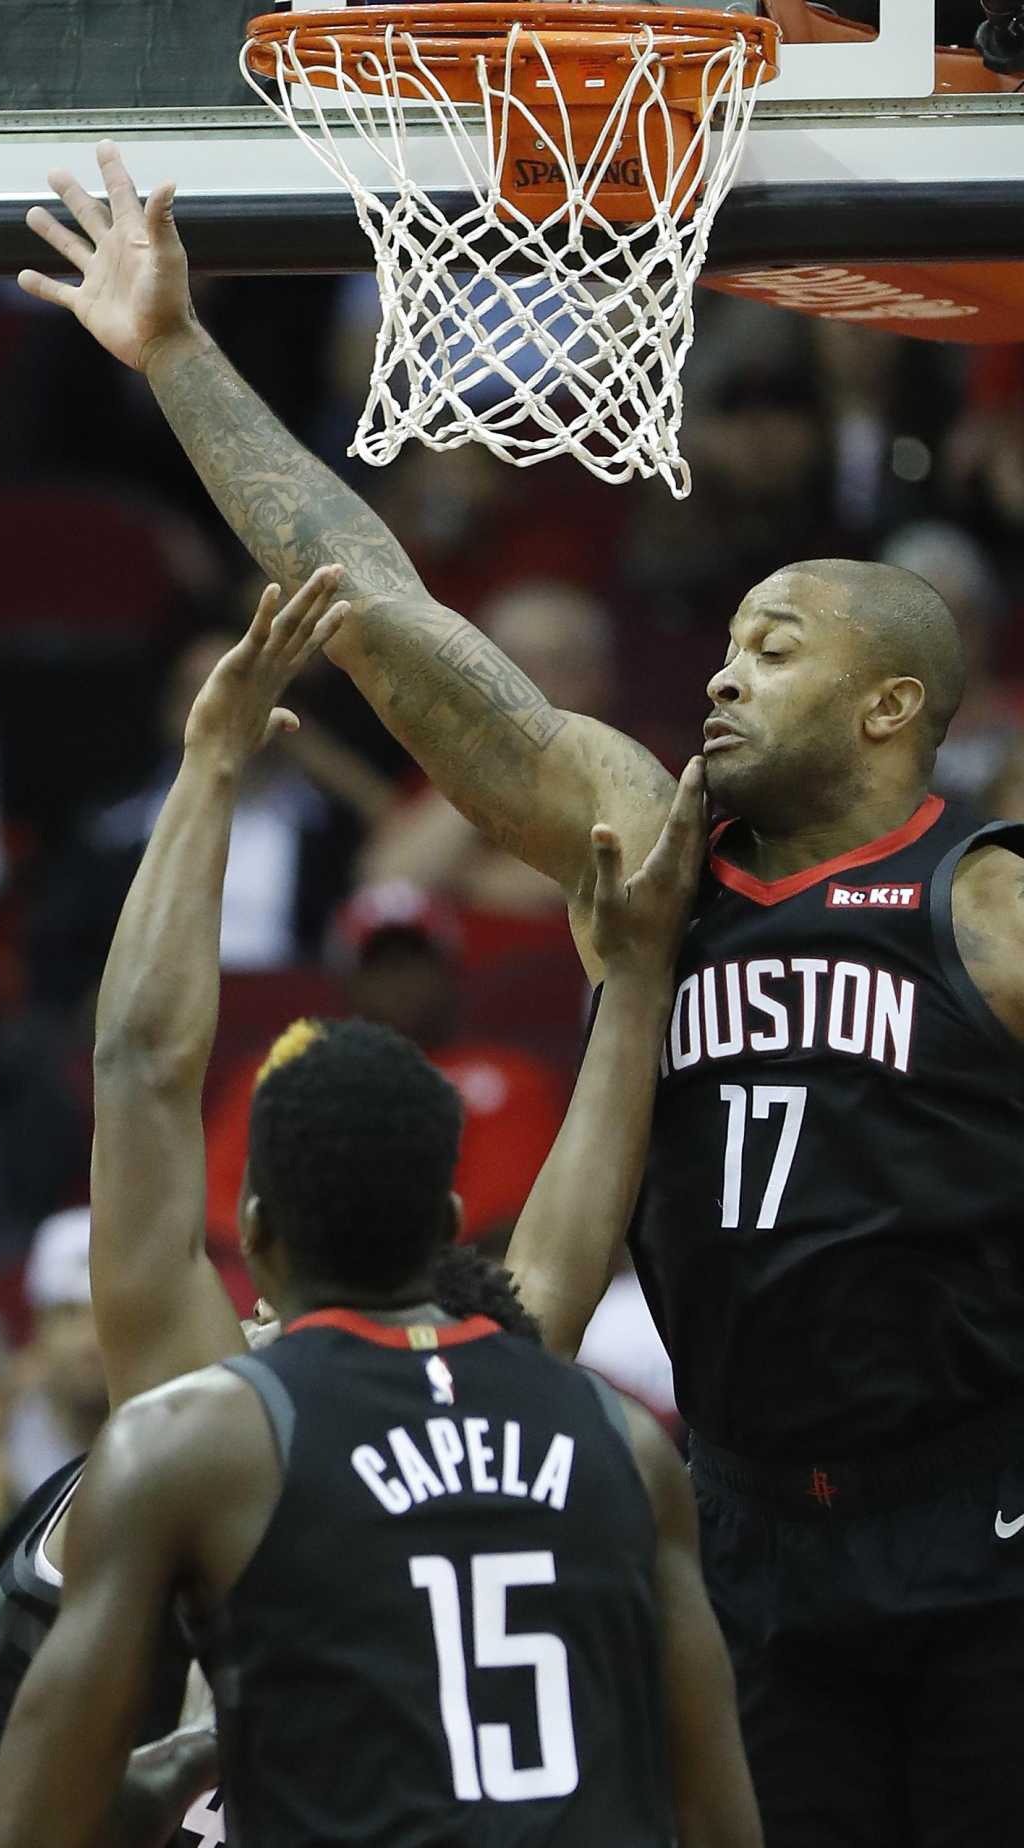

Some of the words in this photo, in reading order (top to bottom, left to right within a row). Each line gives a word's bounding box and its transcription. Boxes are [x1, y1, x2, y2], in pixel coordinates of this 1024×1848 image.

[660, 957, 915, 1079] OUSTON
[719, 1084, 808, 1230] 17
[350, 1416, 576, 1515] CAPELA
[408, 1550, 579, 1802] 15
